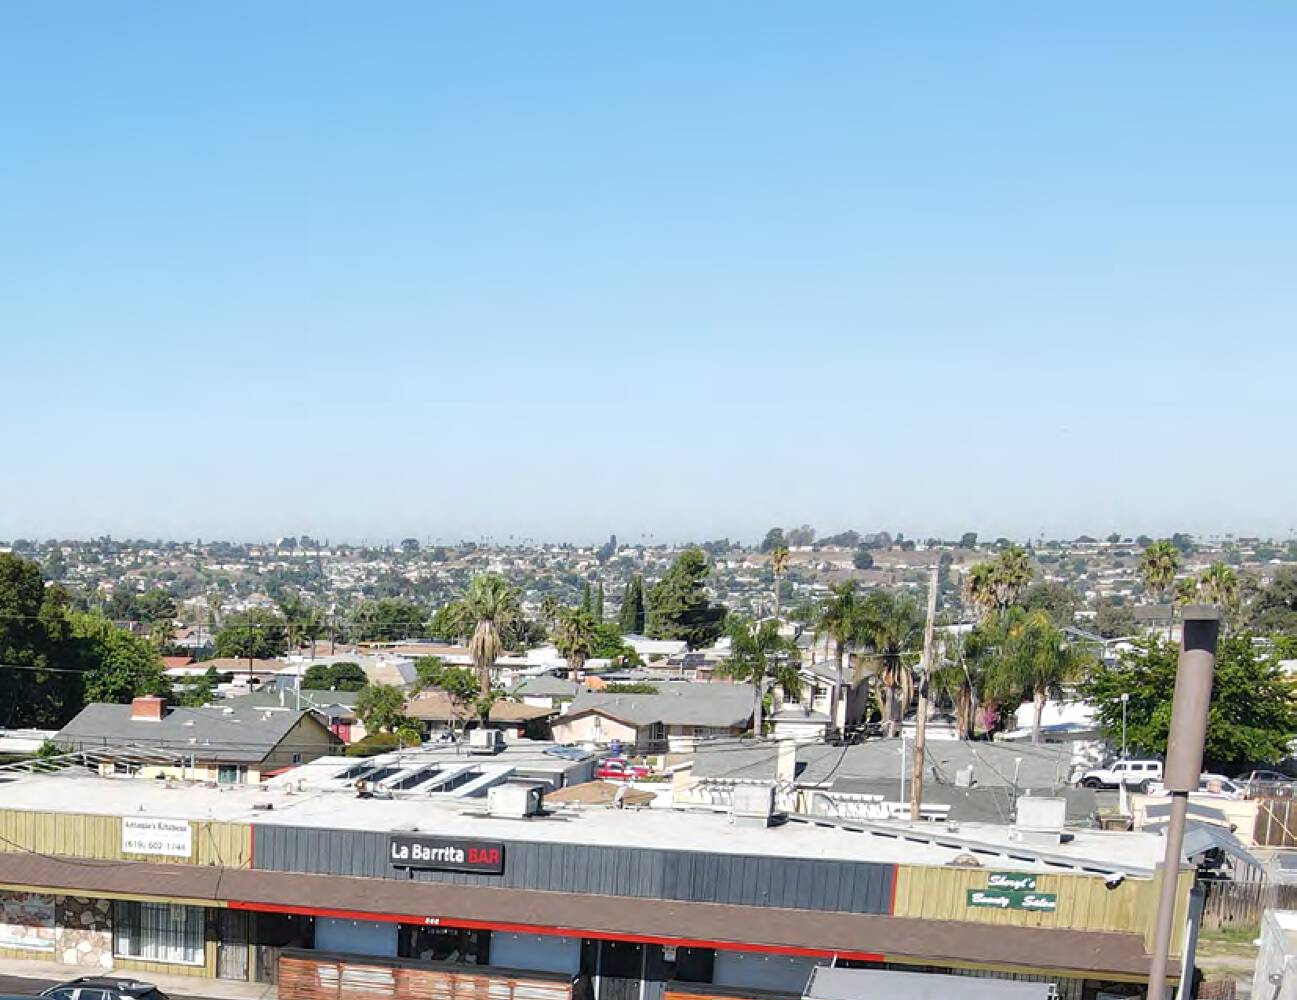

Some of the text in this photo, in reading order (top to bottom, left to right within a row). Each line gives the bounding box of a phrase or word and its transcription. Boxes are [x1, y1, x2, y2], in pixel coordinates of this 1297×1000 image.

[391, 842, 500, 865] La Barrita BAR
